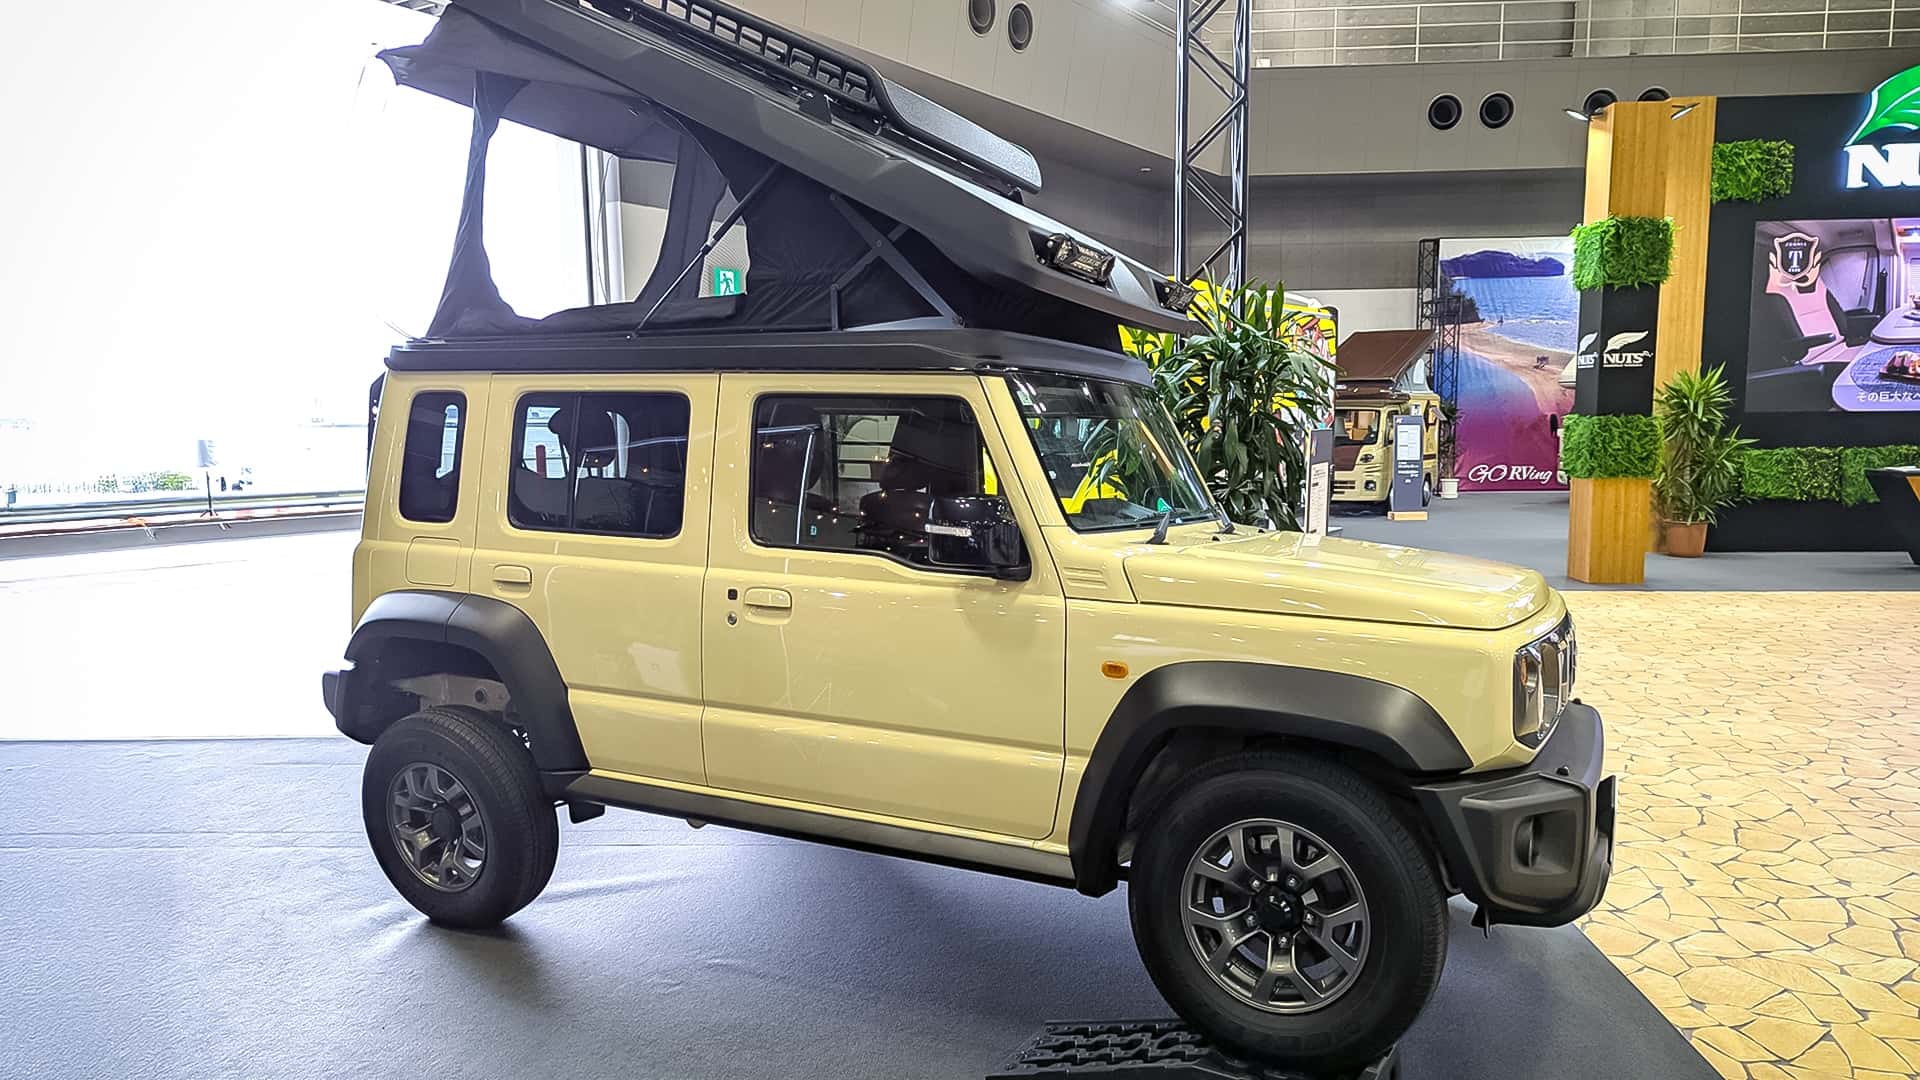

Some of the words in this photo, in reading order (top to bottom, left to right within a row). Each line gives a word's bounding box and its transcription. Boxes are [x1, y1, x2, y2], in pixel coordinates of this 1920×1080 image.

[1789, 250, 1803, 268] T
[1603, 352, 1644, 364] NUTS
[1468, 464, 1508, 484] GO
[1507, 465, 1553, 485] RVing
